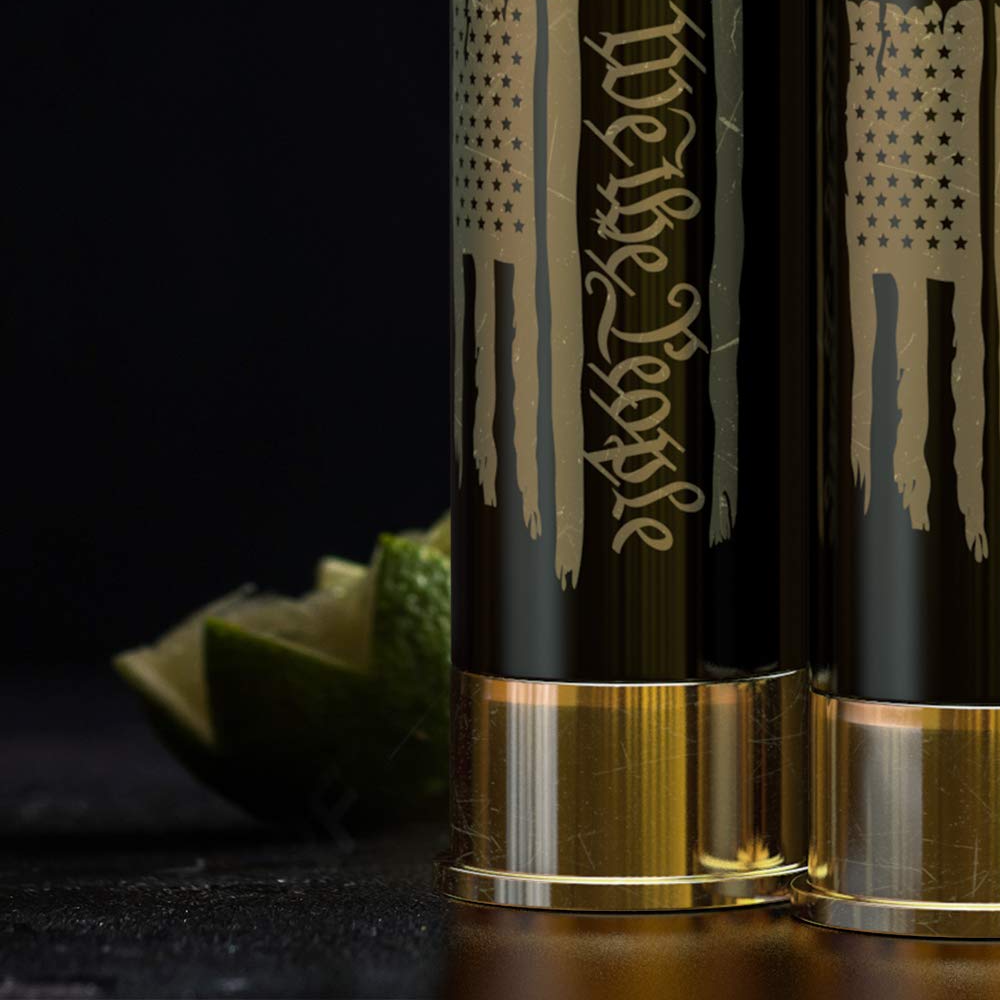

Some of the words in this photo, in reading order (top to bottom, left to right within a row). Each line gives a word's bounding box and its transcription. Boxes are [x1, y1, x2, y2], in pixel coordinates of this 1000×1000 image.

[584, 1, 707, 168] We
[584, 160, 701, 297] the
[583, 272, 709, 554] People
